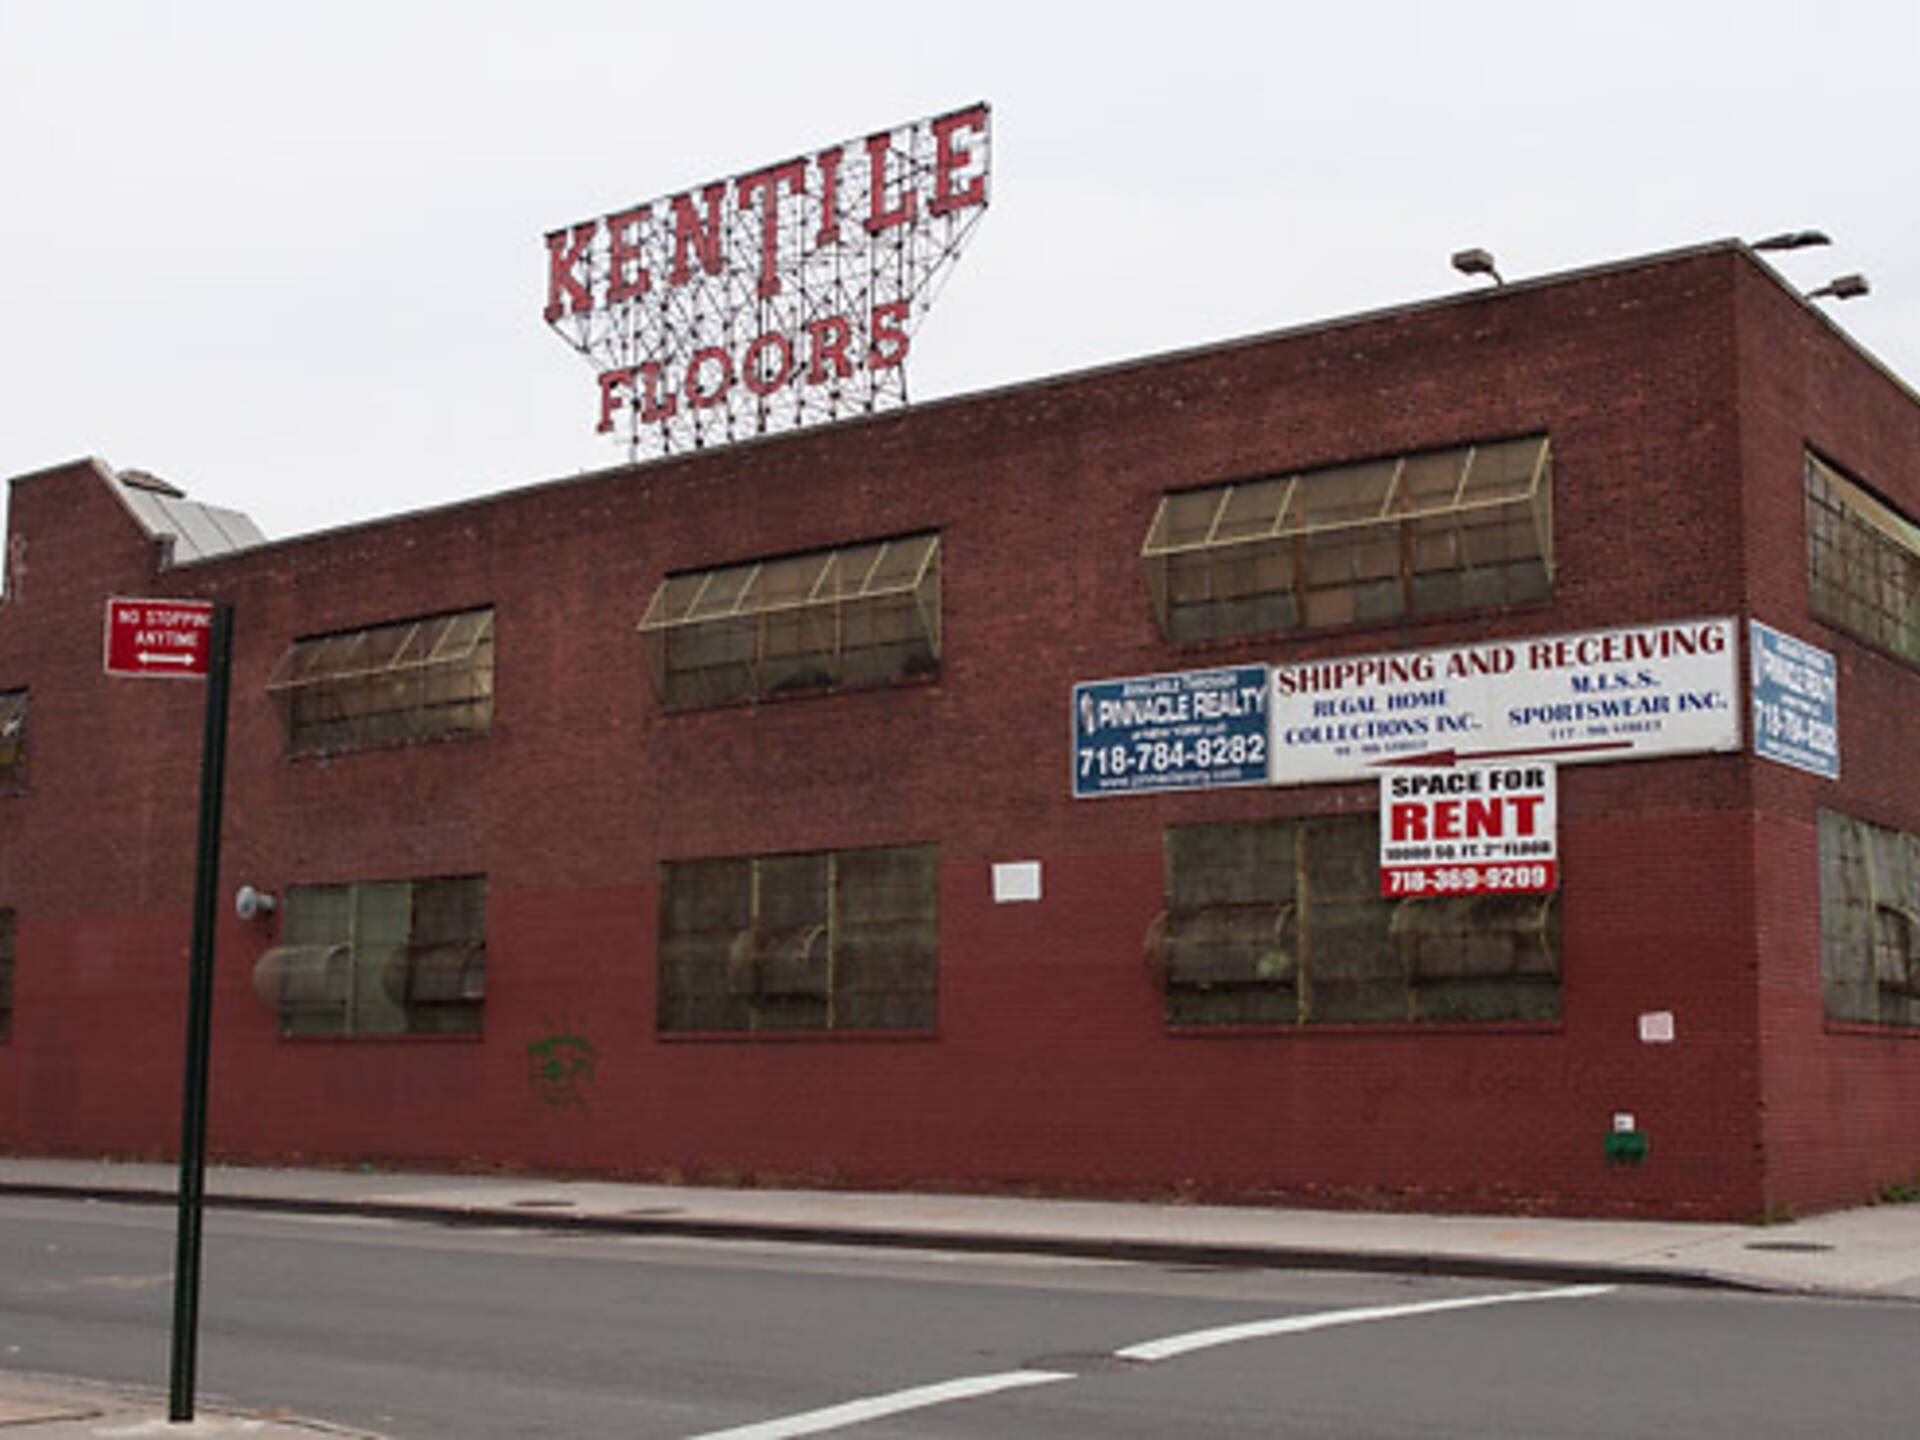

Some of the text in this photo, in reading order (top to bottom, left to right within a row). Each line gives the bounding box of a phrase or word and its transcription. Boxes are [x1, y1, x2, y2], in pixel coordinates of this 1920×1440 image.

[543, 104, 988, 322] KENTILE
[596, 301, 910, 433] FLOORS
[119, 610, 139, 623] NO
[135, 631, 198, 647] ANYTIME
[1278, 625, 1725, 697] SHIPPING AND RECEIVING
[1099, 686, 1268, 727] PINNACLE REALTY
[1313, 689, 1446, 717] REGAL HOME
[1508, 695, 1670, 726] SPORTSWEAR
[1285, 717, 1429, 745] COLLECTIONS
[1080, 734, 1266, 777] 718-784-8282
[1391, 769, 1545, 797] SPACE FOR
[1391, 795, 1545, 841] RENT
